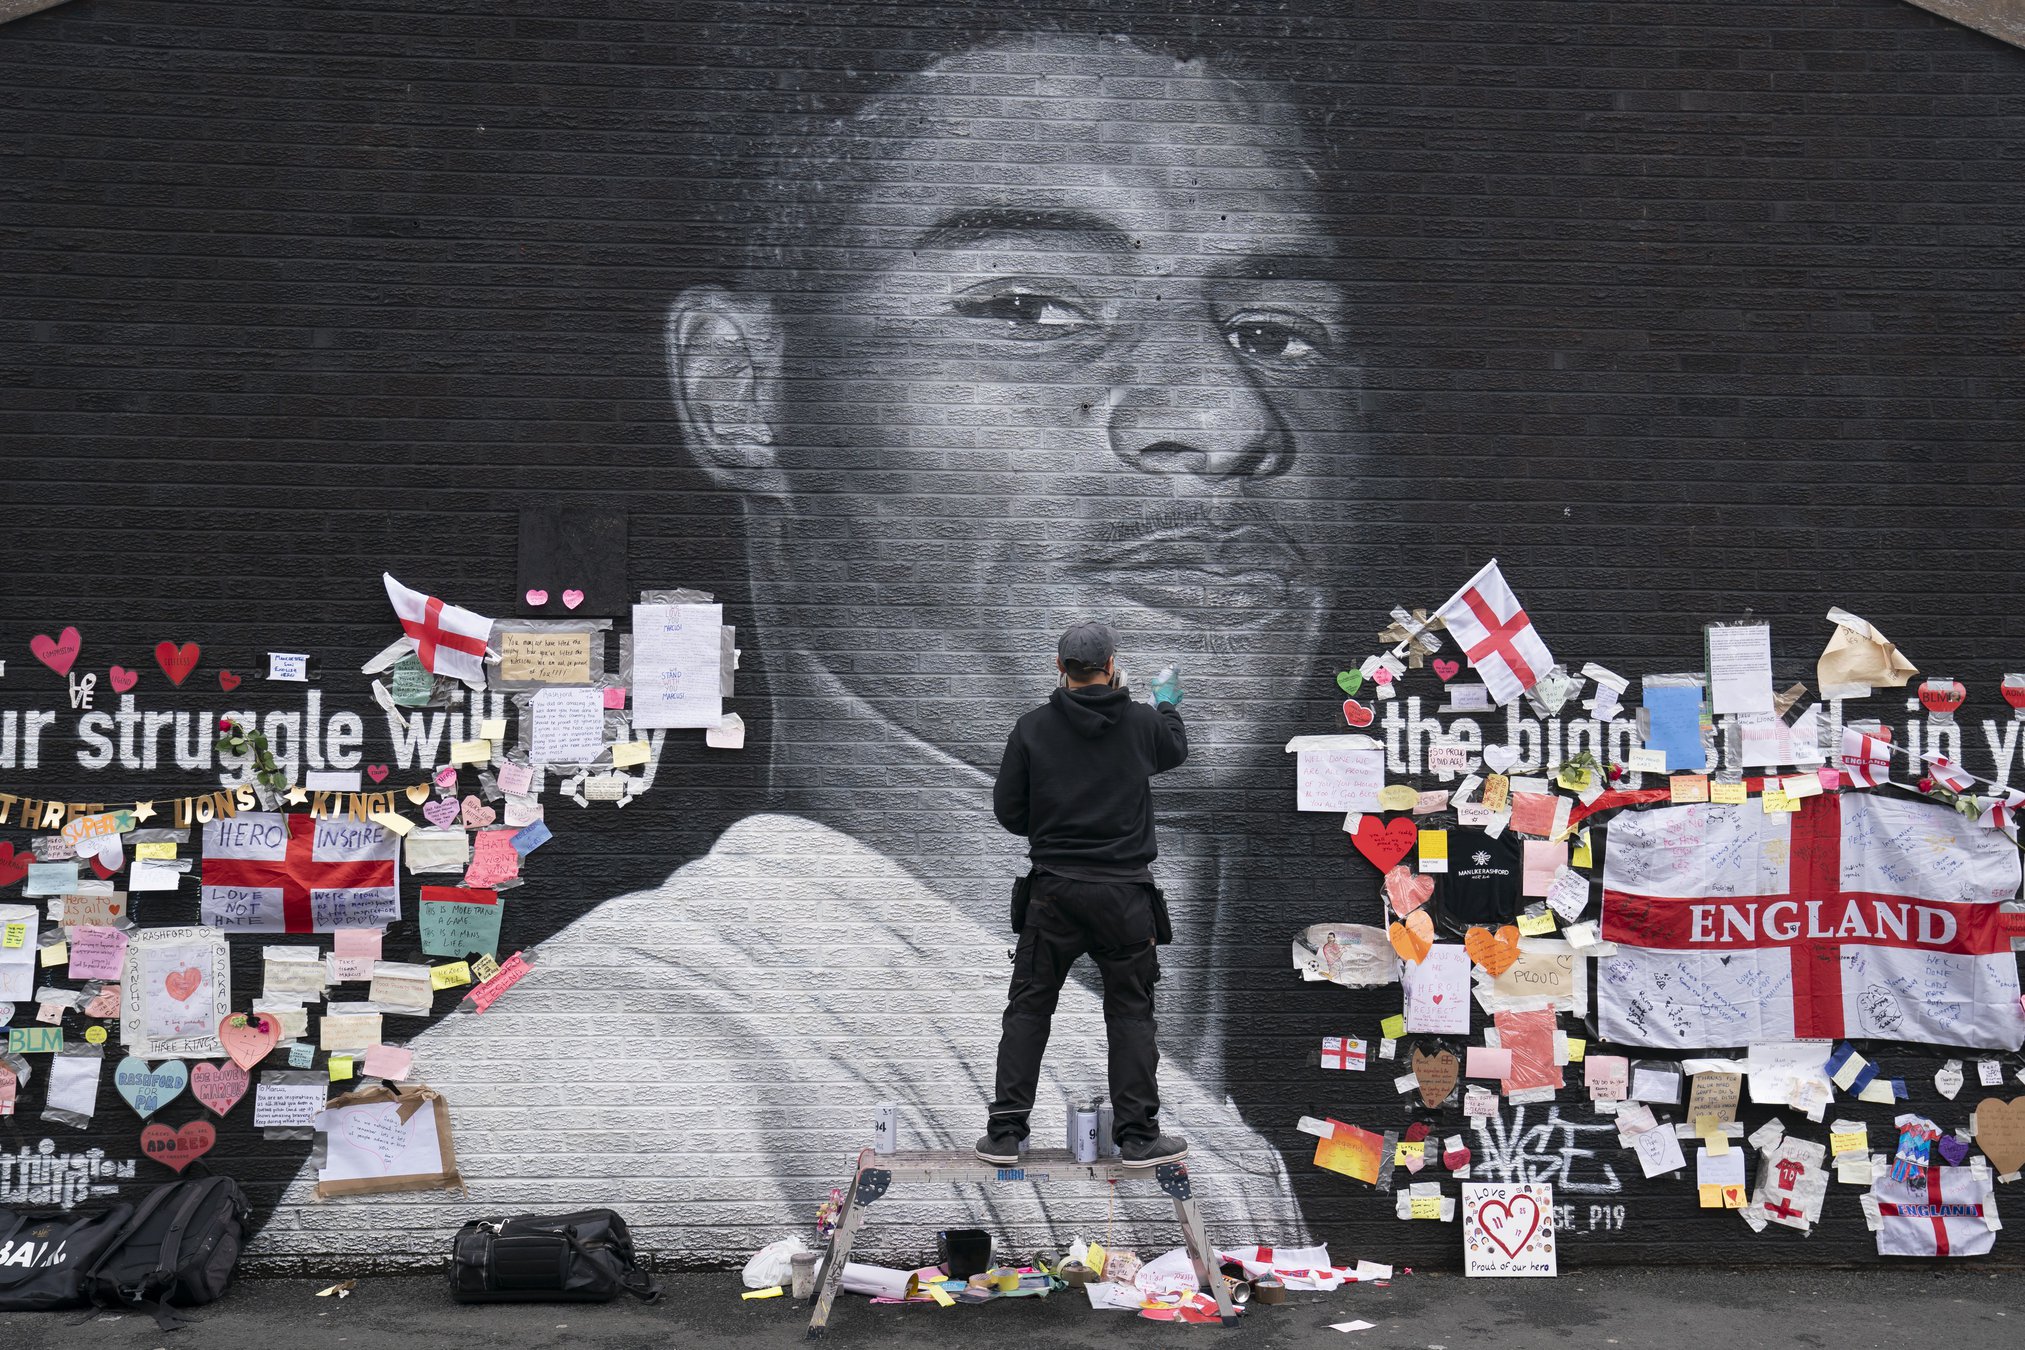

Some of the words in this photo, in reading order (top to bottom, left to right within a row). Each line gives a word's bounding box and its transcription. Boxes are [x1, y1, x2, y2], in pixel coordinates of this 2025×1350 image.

[661, 671, 682, 680] STAND
[77, 689, 363, 791] struggle
[1844, 757, 1888, 767] ENGLAND
[1983, 719, 2025, 796] y
[174, 784, 256, 828] LIONS
[1460, 808, 1490, 816] LEGEND
[62, 813, 115, 846] SUPER
[219, 821, 283, 849] HERO
[317, 825, 385, 849] INSPIRE
[212, 889, 264, 900] LOVE
[85, 903, 101, 913] all
[226, 903, 261, 916] NOT
[452, 904, 472, 915] MORE
[214, 916, 265, 927] HATE
[1689, 899, 1958, 945] ENGLAND
[143, 929, 193, 941] RASHFORD
[1513, 970, 1560, 986] PROUD
[1925, 967, 1952, 978] DONE
[10, 1028, 63, 1053] BLM
[151, 1040, 178, 1053] THREE
[184, 1036, 219, 1052] KINGS
[118, 1072, 184, 1090] RASHFORD
[138, 1087, 158, 1096] FOR
[200, 1081, 246, 1100] MARCUS
[135, 1095, 158, 1111] PM
[147, 1136, 209, 1153] ADORED
[1474, 1187, 1506, 1201] Love
[1589, 1204, 1626, 1230] P19
[1897, 1203, 1979, 1217] ENGLAND
[1492, 1216, 1504, 1230] 11
[1471, 1261, 1497, 1272] Proud
[1500, 1261, 1511, 1271] of
[1512, 1263, 1527, 1272] our
[1530, 1261, 1550, 1272] hero
